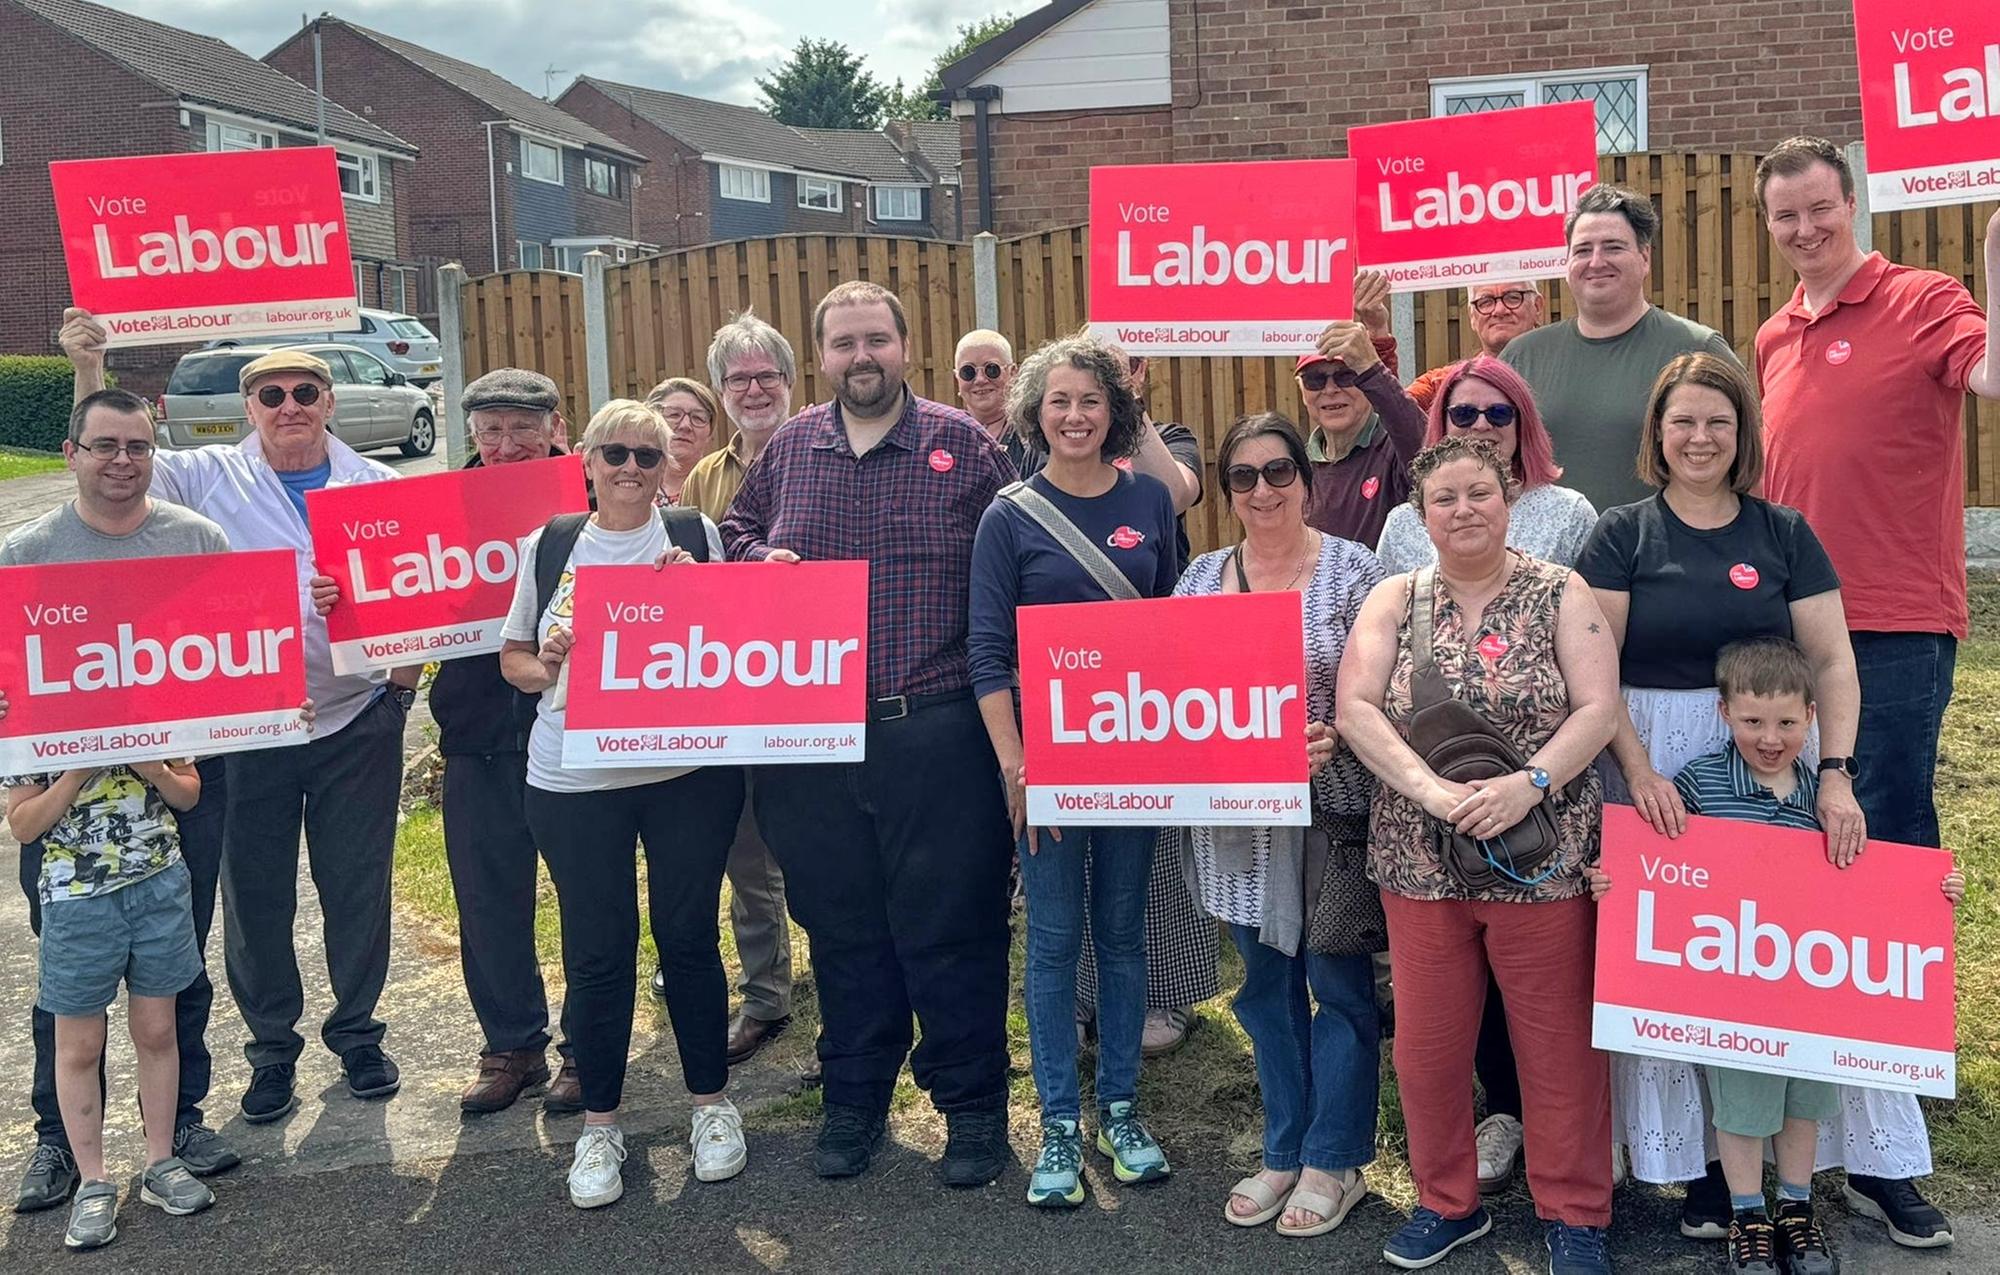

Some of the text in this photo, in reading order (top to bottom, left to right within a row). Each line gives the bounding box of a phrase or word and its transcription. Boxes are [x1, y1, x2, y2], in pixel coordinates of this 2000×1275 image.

[1891, 26, 1954, 54] Vote
[1377, 156, 1425, 176] Vote
[88, 196, 146, 217] Vote
[1118, 202, 1170, 223] Vote
[1378, 171, 1592, 233] Labour
[93, 215, 339, 280] Labour
[1117, 225, 1347, 287] Labour
[1519, 257, 1567, 270] labour.o
[266, 307, 351, 323] labour.org.uk
[1262, 331, 1320, 342] labour.or
[343, 519, 400, 542] Vote
[347, 533, 527, 604] Labo
[24, 604, 88, 626] Vote
[606, 601, 665, 623] Vote
[25, 623, 294, 696] Labour
[600, 625, 859, 691] Labour
[1048, 646, 1102, 671] Vote
[1049, 671, 1297, 743] Labour
[209, 719, 301, 740] labour.org.uk
[764, 734, 857, 752] labour.org.uk
[1209, 795, 1302, 813] labour.org.uk
[1640, 854, 1710, 888] Vote
[1635, 889, 1944, 1000] Labour
[1833, 1050, 1945, 1081] labour.org.uk
